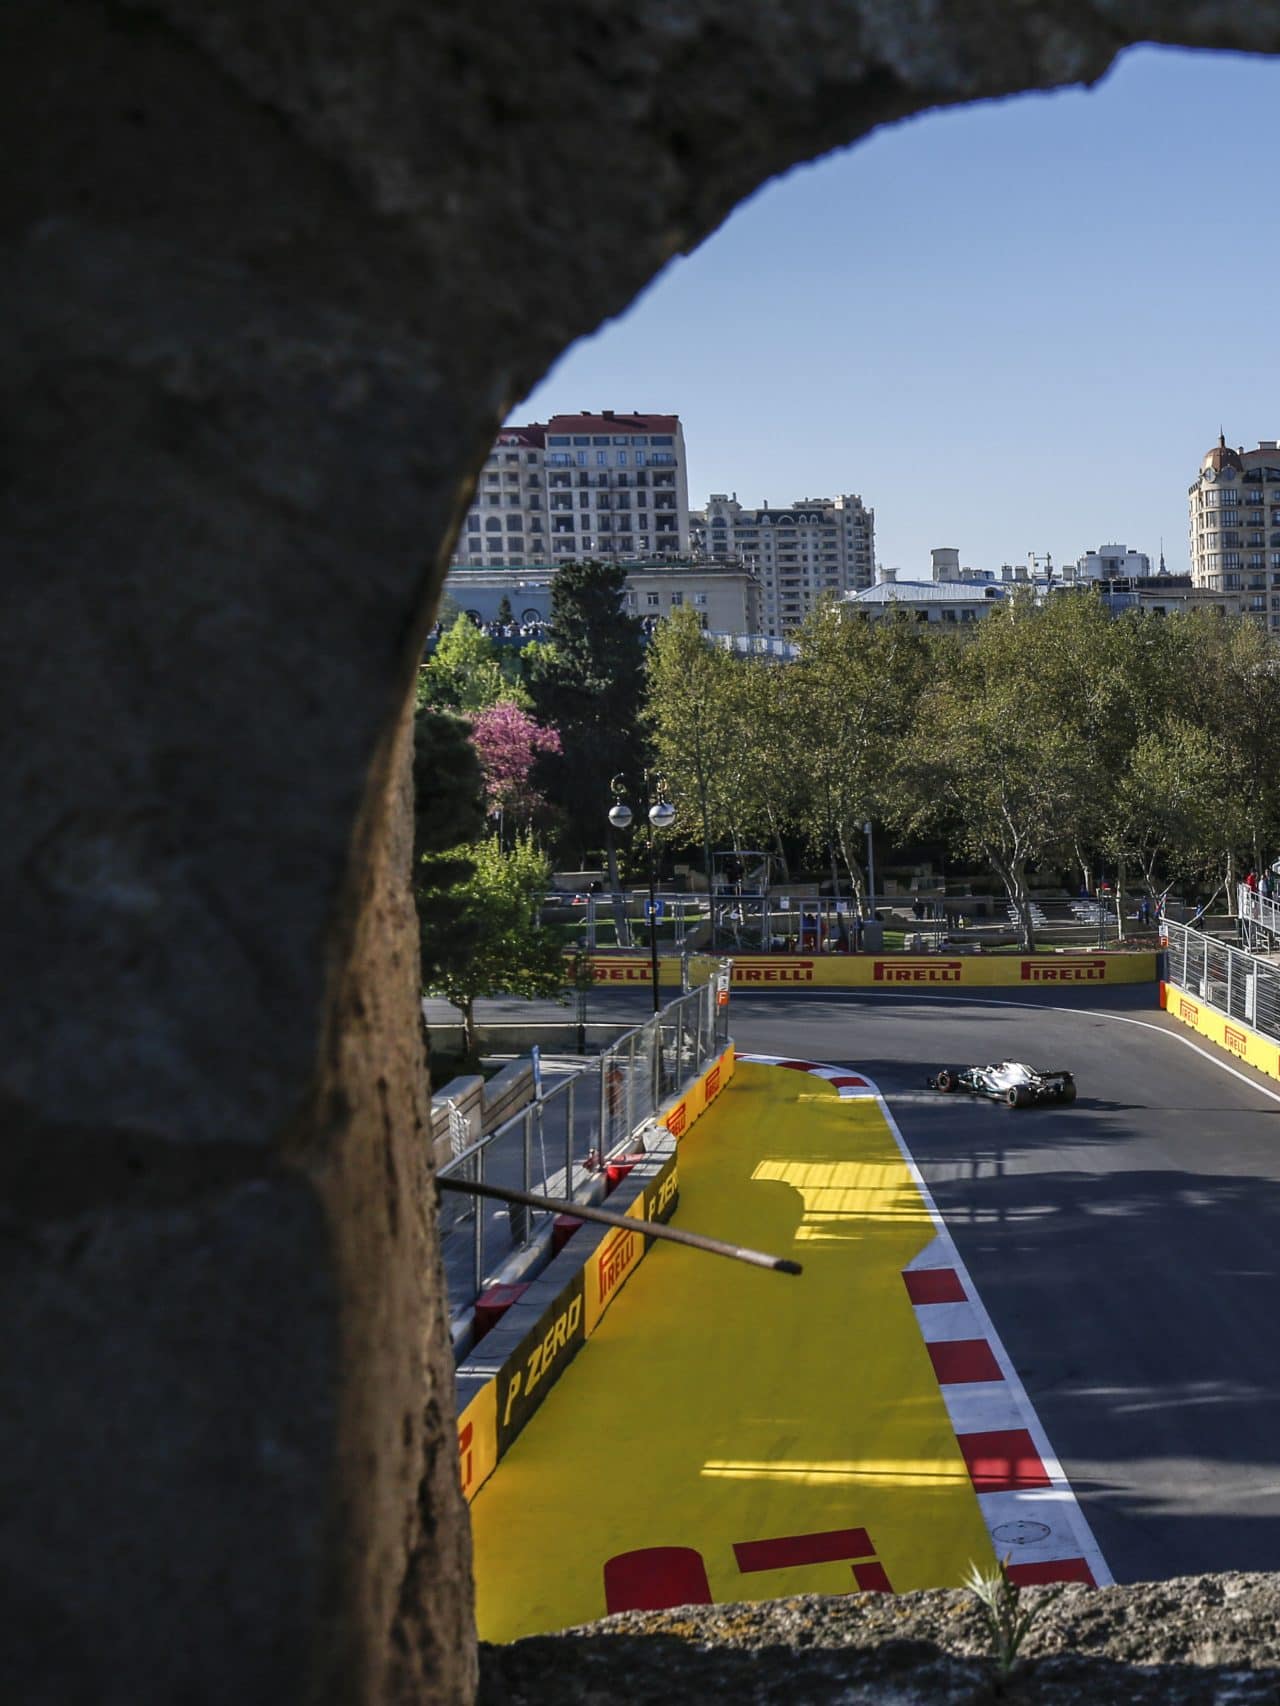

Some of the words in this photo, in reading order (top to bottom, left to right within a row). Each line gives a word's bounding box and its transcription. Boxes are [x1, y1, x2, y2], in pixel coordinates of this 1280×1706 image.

[874, 961, 962, 981] PIRELLI
[1021, 960, 1106, 980] PIRELLI
[1180, 998, 1198, 1026] PIRELLI
[1225, 1025, 1247, 1056] PIRELLI
[504, 1371, 521, 1426] P
[525, 1294, 581, 1396] ZERO
